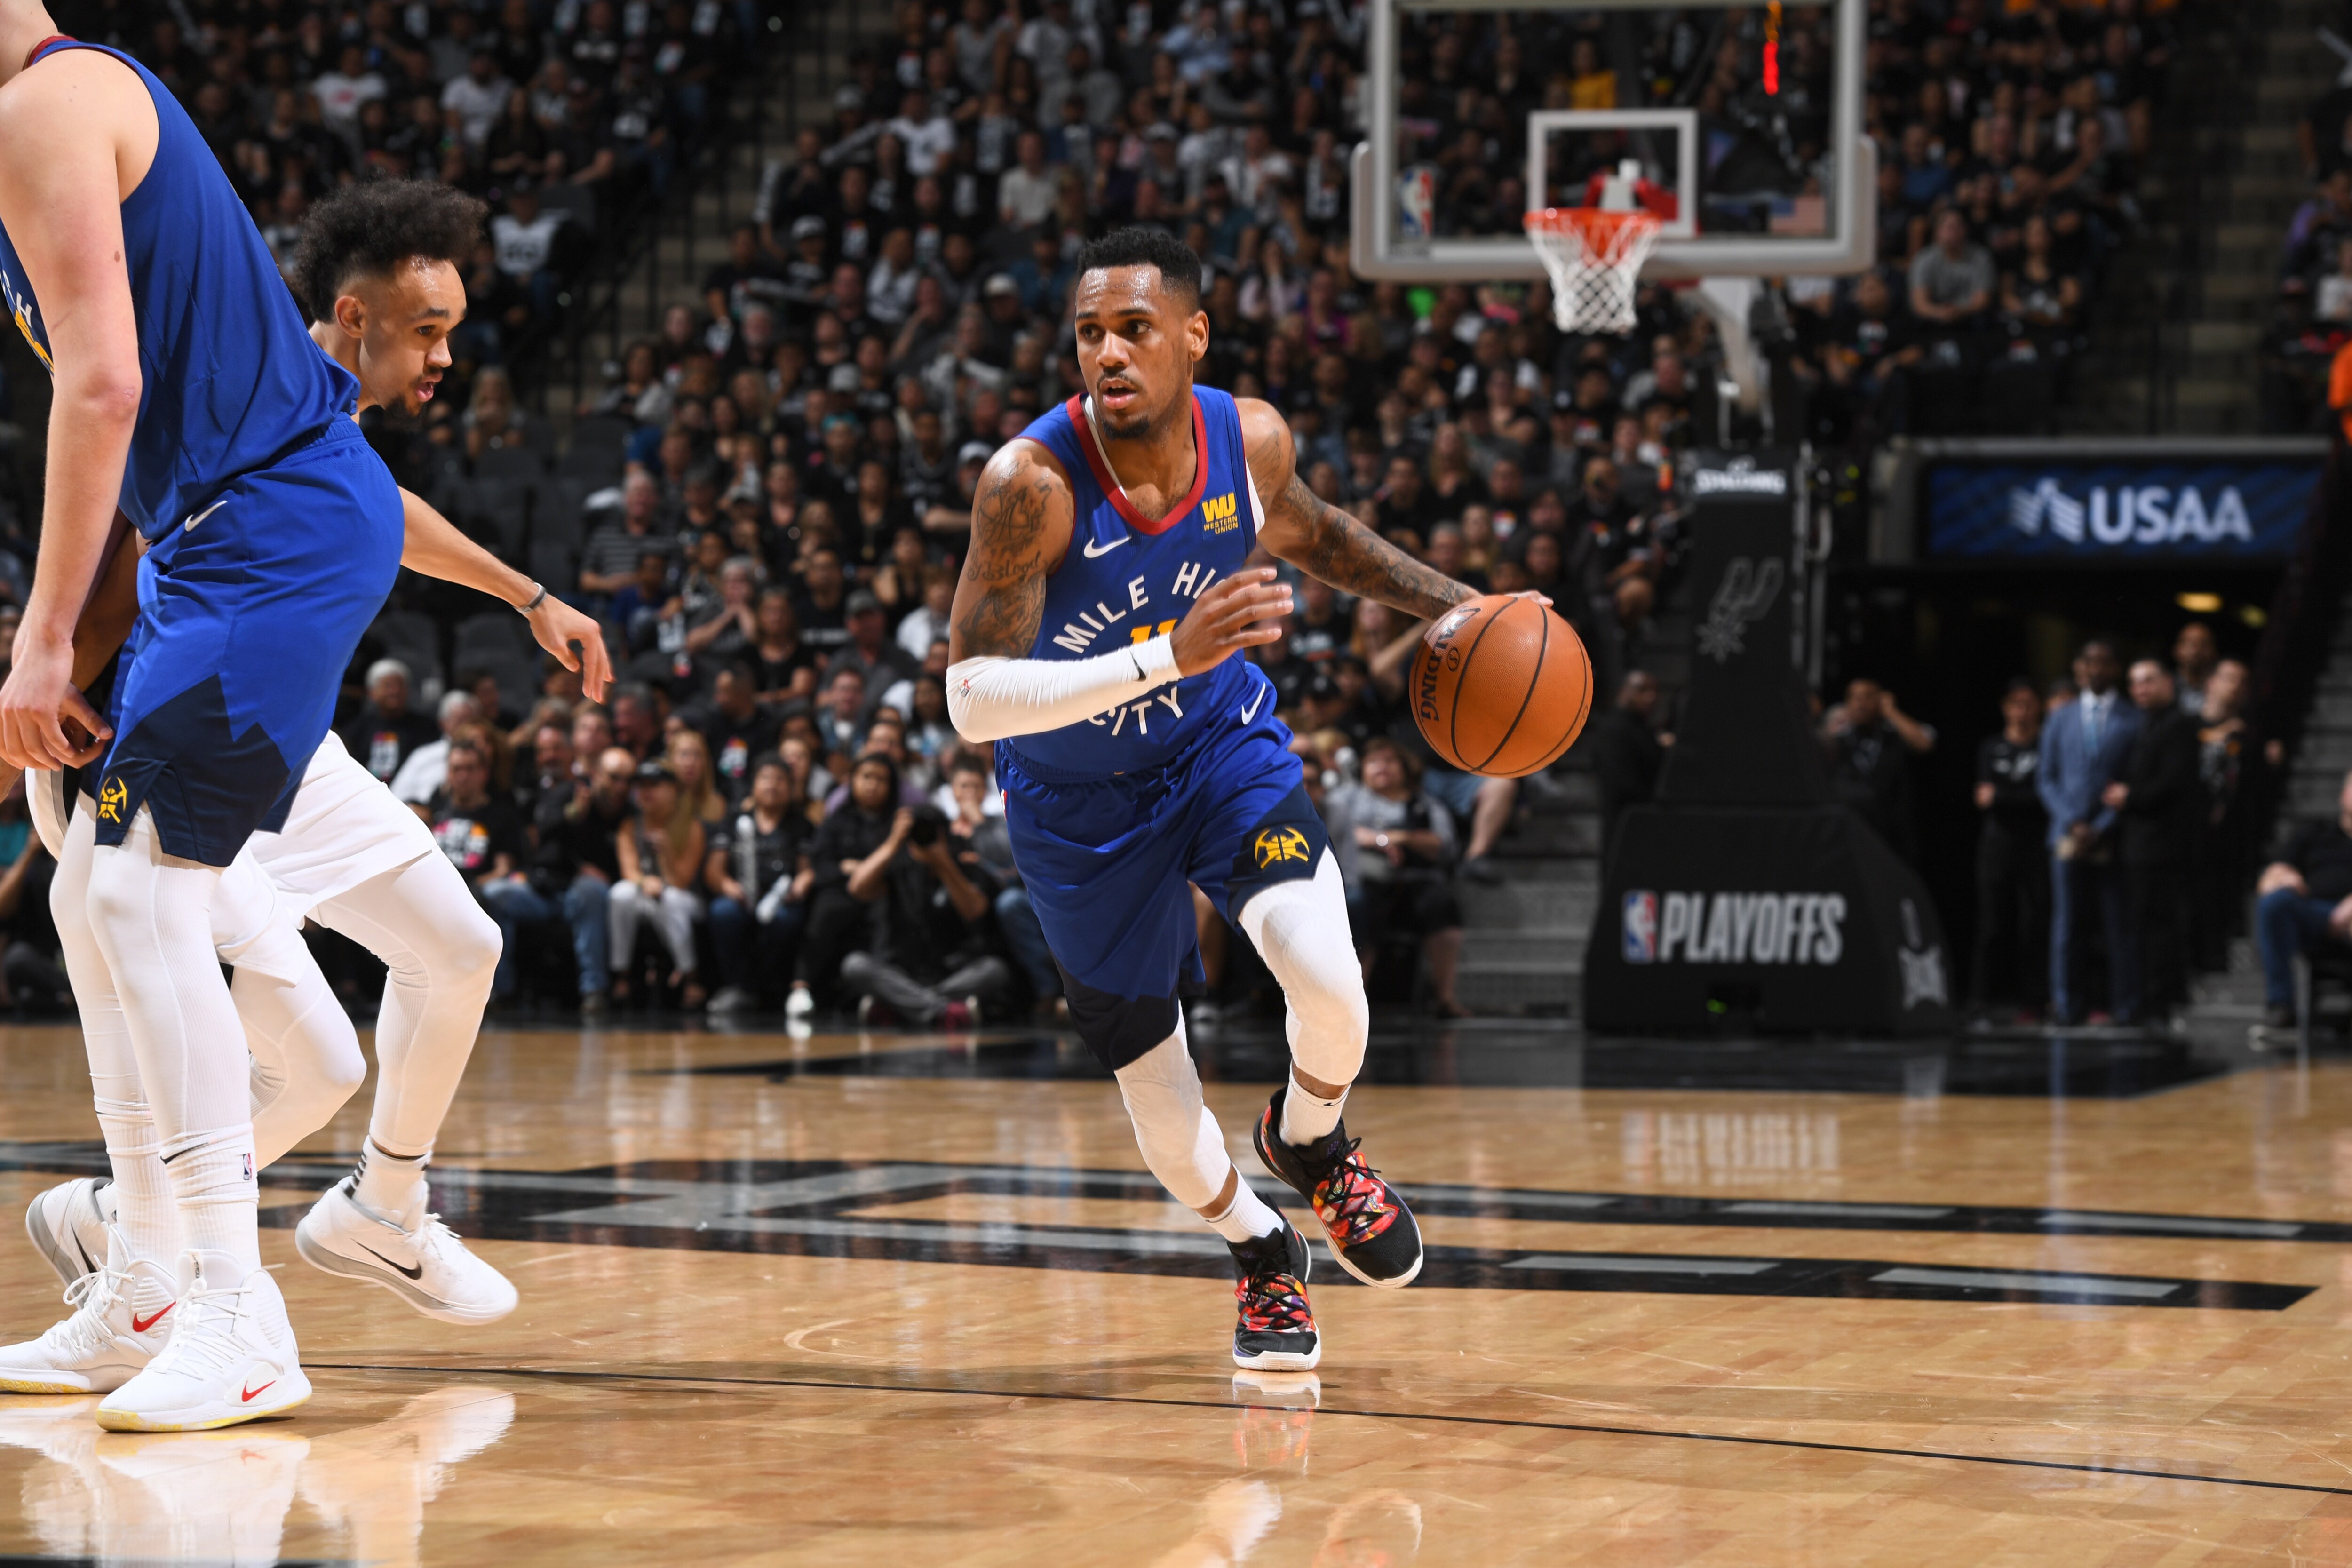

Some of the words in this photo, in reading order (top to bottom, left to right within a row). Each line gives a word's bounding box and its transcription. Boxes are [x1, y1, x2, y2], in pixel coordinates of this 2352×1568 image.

[1202, 492, 1236, 522] WU
[1204, 515, 1238, 531] WESTERN
[1215, 522, 1238, 534] UNION
[2089, 485, 2254, 544] USAA
[1053, 575, 1149, 653] MILE
[1172, 561, 1226, 599] HI
[1659, 893, 1846, 964] PLAYOFFS
